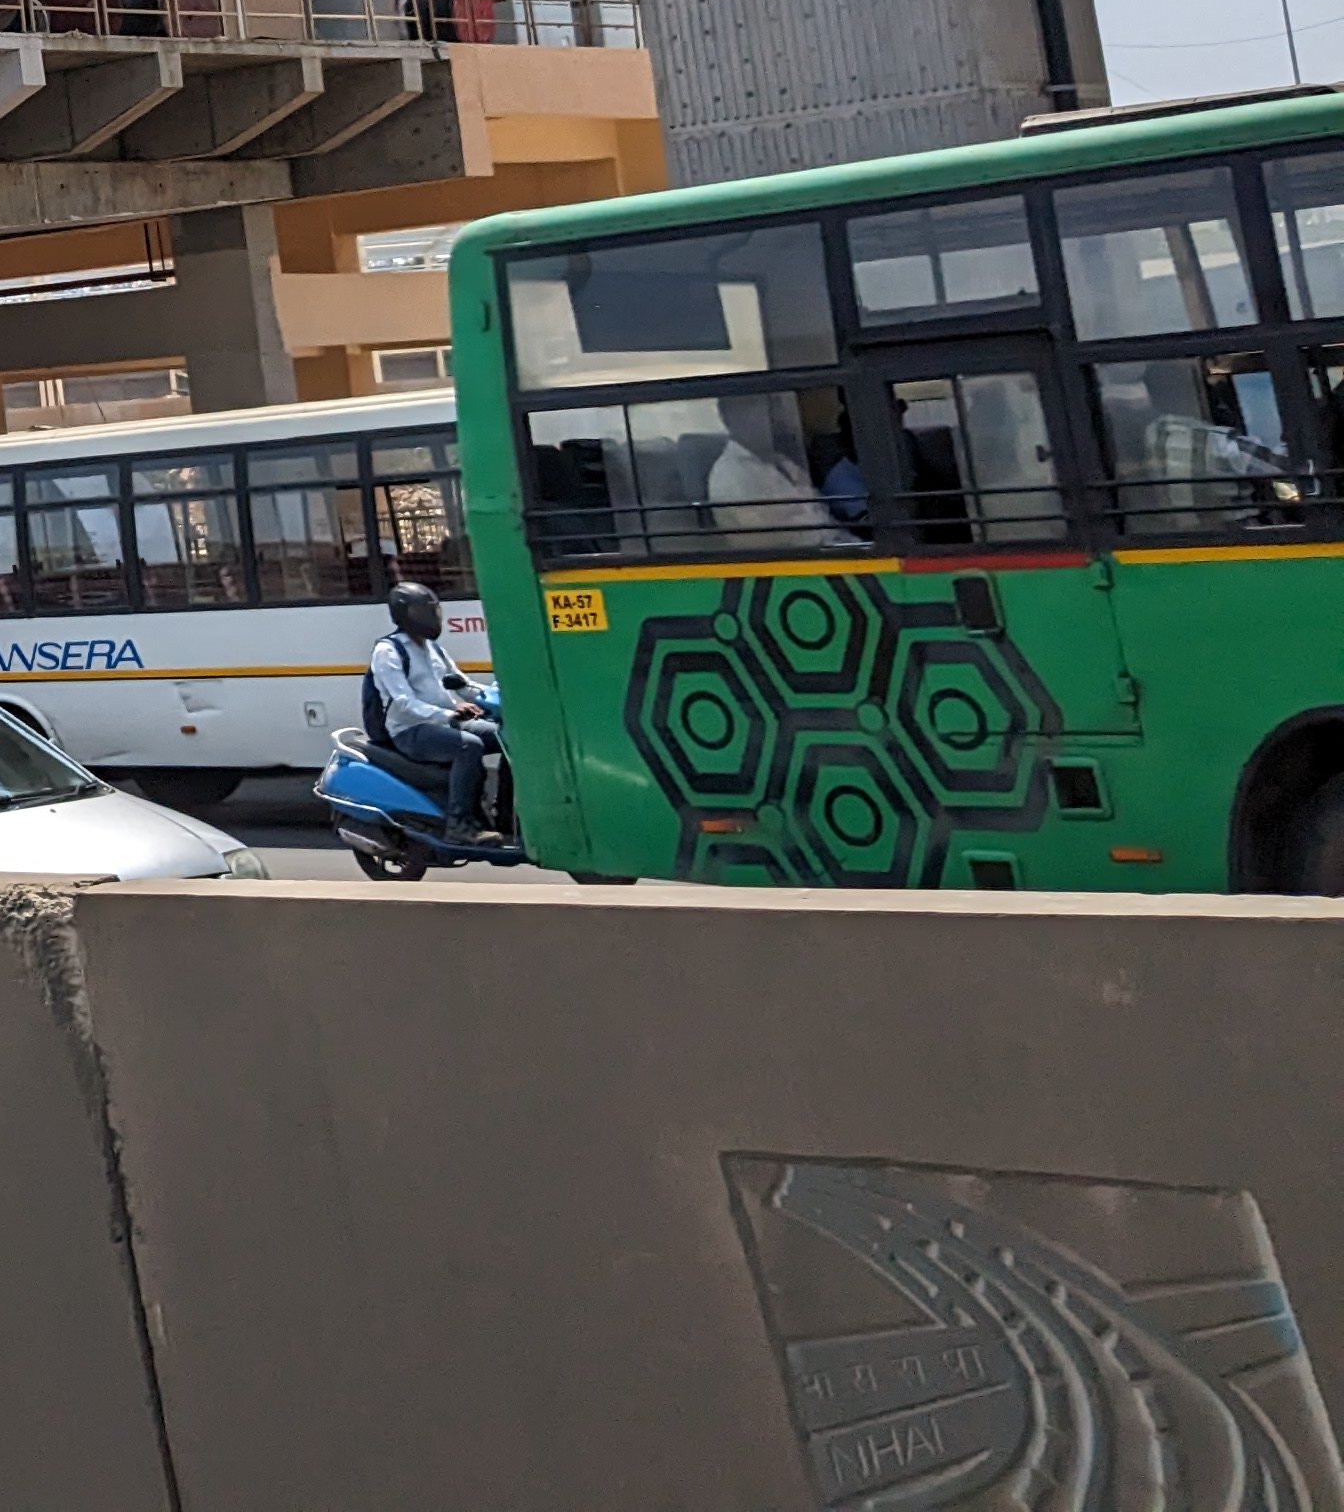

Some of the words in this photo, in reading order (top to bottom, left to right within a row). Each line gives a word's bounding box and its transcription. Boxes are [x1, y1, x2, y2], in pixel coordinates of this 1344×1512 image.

[551, 594, 593, 610] KA-57
[551, 612, 598, 629] F-3417
[830, 1414, 946, 1485] NHAI
